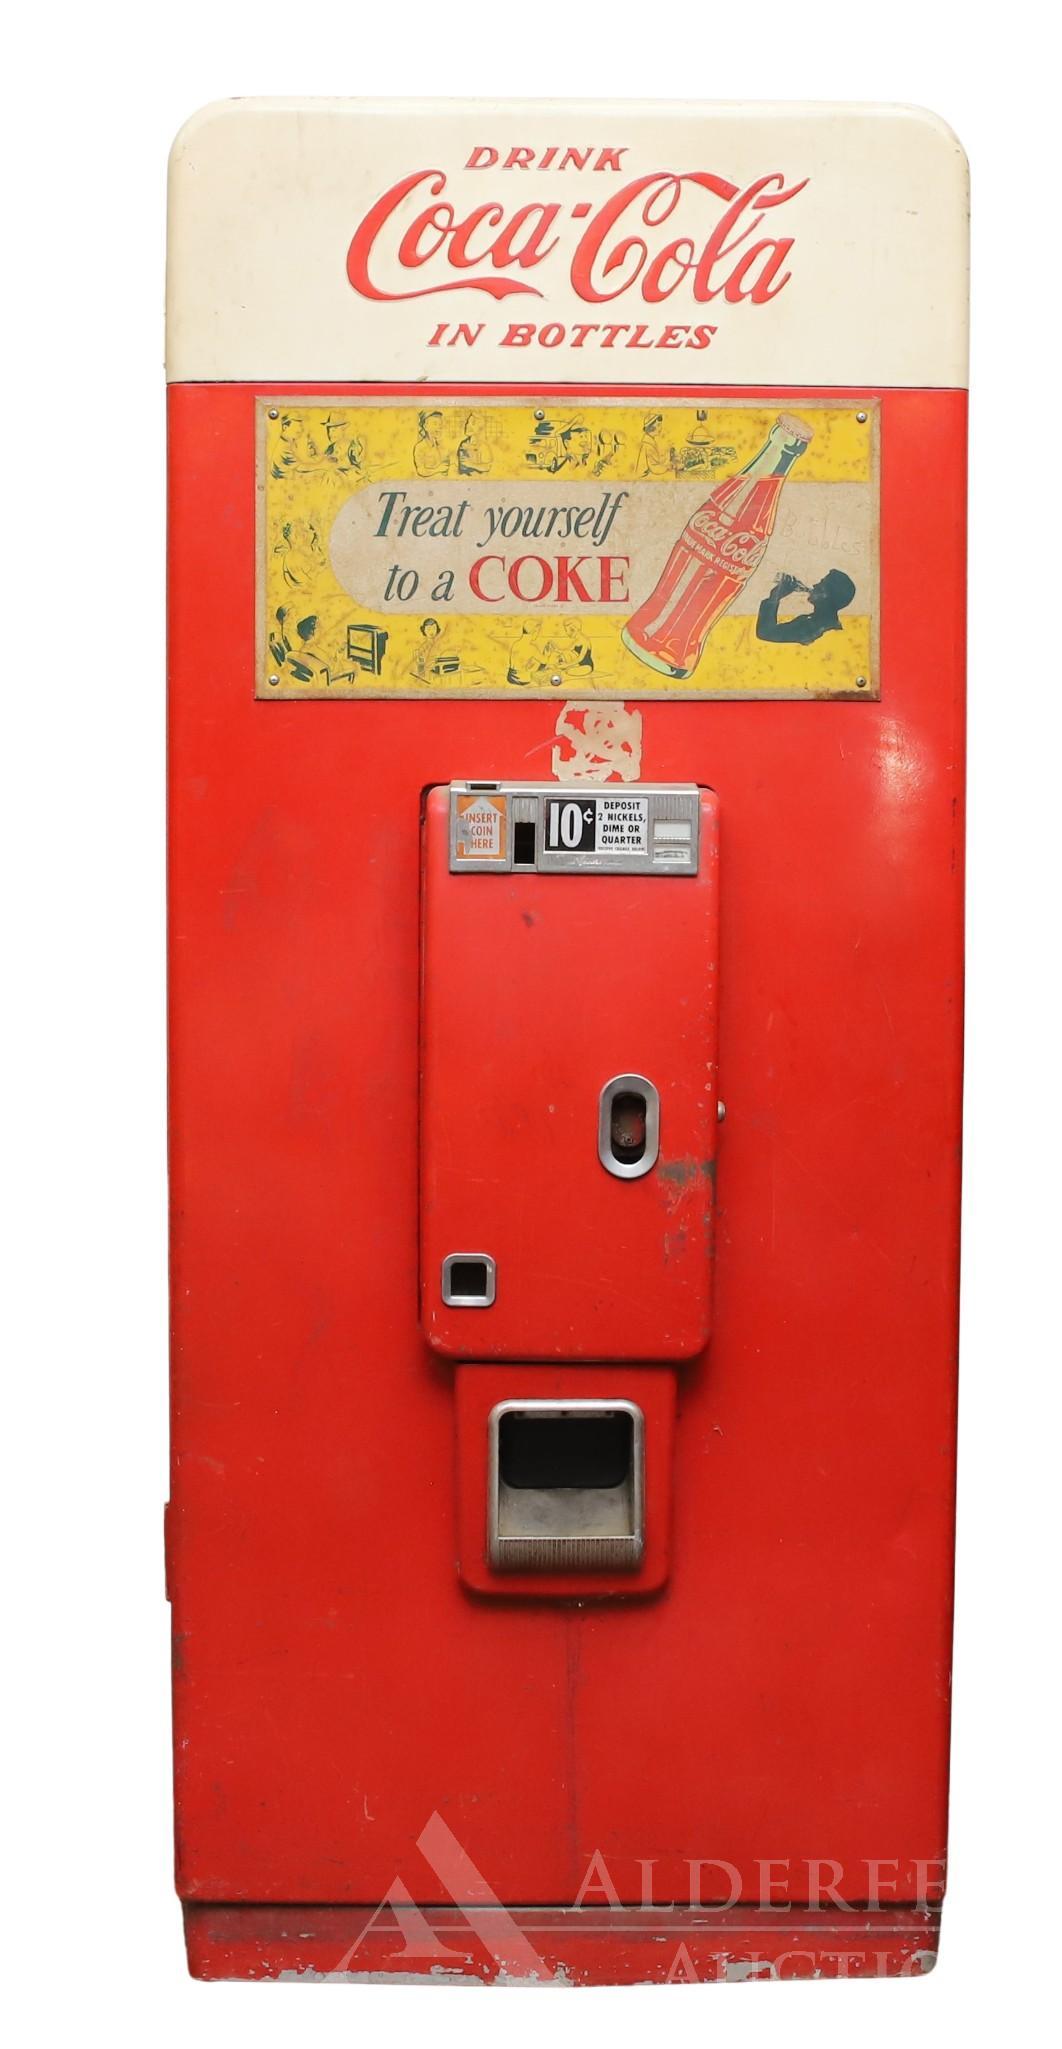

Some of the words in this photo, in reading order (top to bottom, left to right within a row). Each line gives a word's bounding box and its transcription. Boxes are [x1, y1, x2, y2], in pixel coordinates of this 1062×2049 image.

[464, 147, 629, 171] DRINK
[346, 169, 810, 303] Coca-Cola
[427, 323, 486, 347] IN
[499, 324, 718, 349] BOTTLES
[373, 491, 471, 538] Treat
[476, 491, 629, 547] yourself
[383, 564, 419, 601] to
[431, 570, 455, 601] a
[468, 555, 630, 603] COKE
[604, 801, 641, 810] DEPOSIT
[465, 812, 497, 823] INSERT
[597, 812, 603, 821] 2
[607, 813, 646, 823] NICKELS,
[549, 802, 594, 848] 10¢
[603, 824, 624, 833] DIME
[628, 824, 640, 833] OR
[471, 826, 493, 836] COIN
[471, 838, 494, 849] HERE
[601, 835, 642, 845] QUARTER
